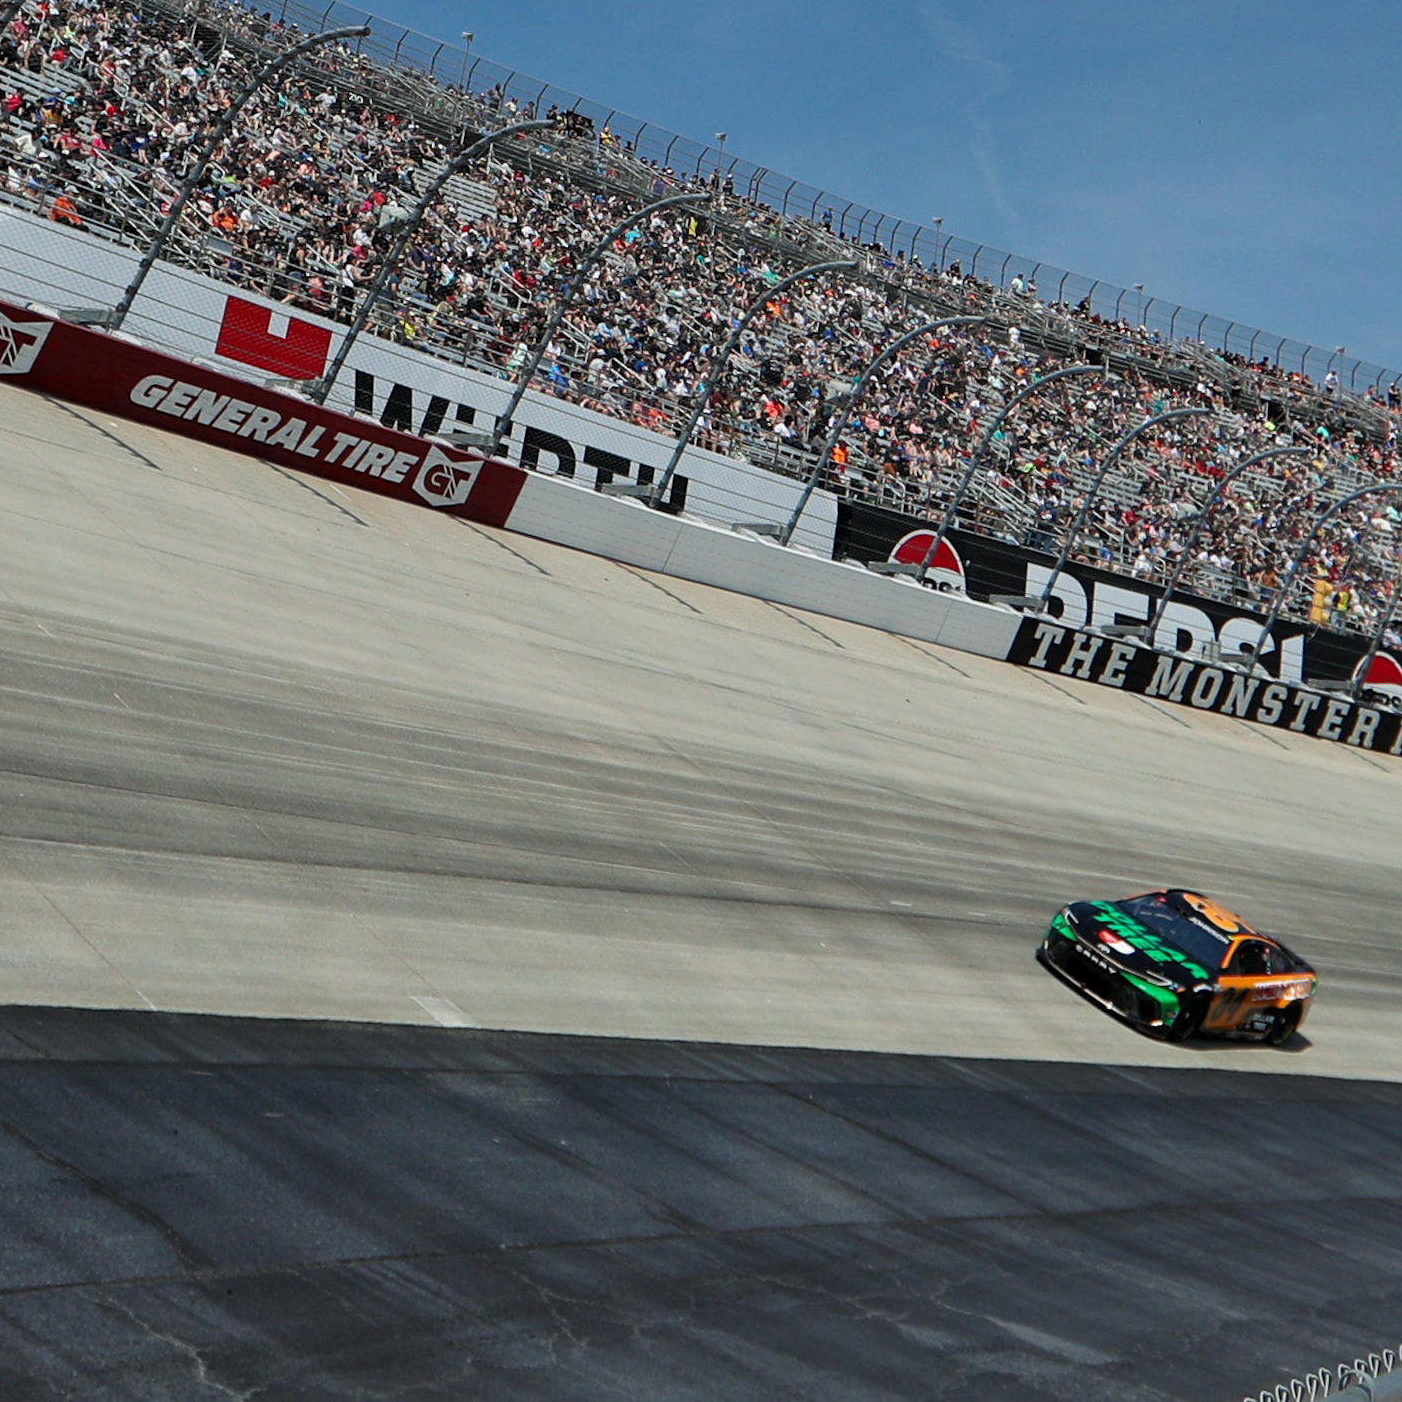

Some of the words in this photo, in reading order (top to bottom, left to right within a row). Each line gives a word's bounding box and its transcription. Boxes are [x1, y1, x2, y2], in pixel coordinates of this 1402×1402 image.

[129, 375, 326, 457] GENERAL
[322, 432, 420, 483] TIRE
[1028, 623, 1136, 687] THE
[1145, 655, 1381, 748] MONSTER
